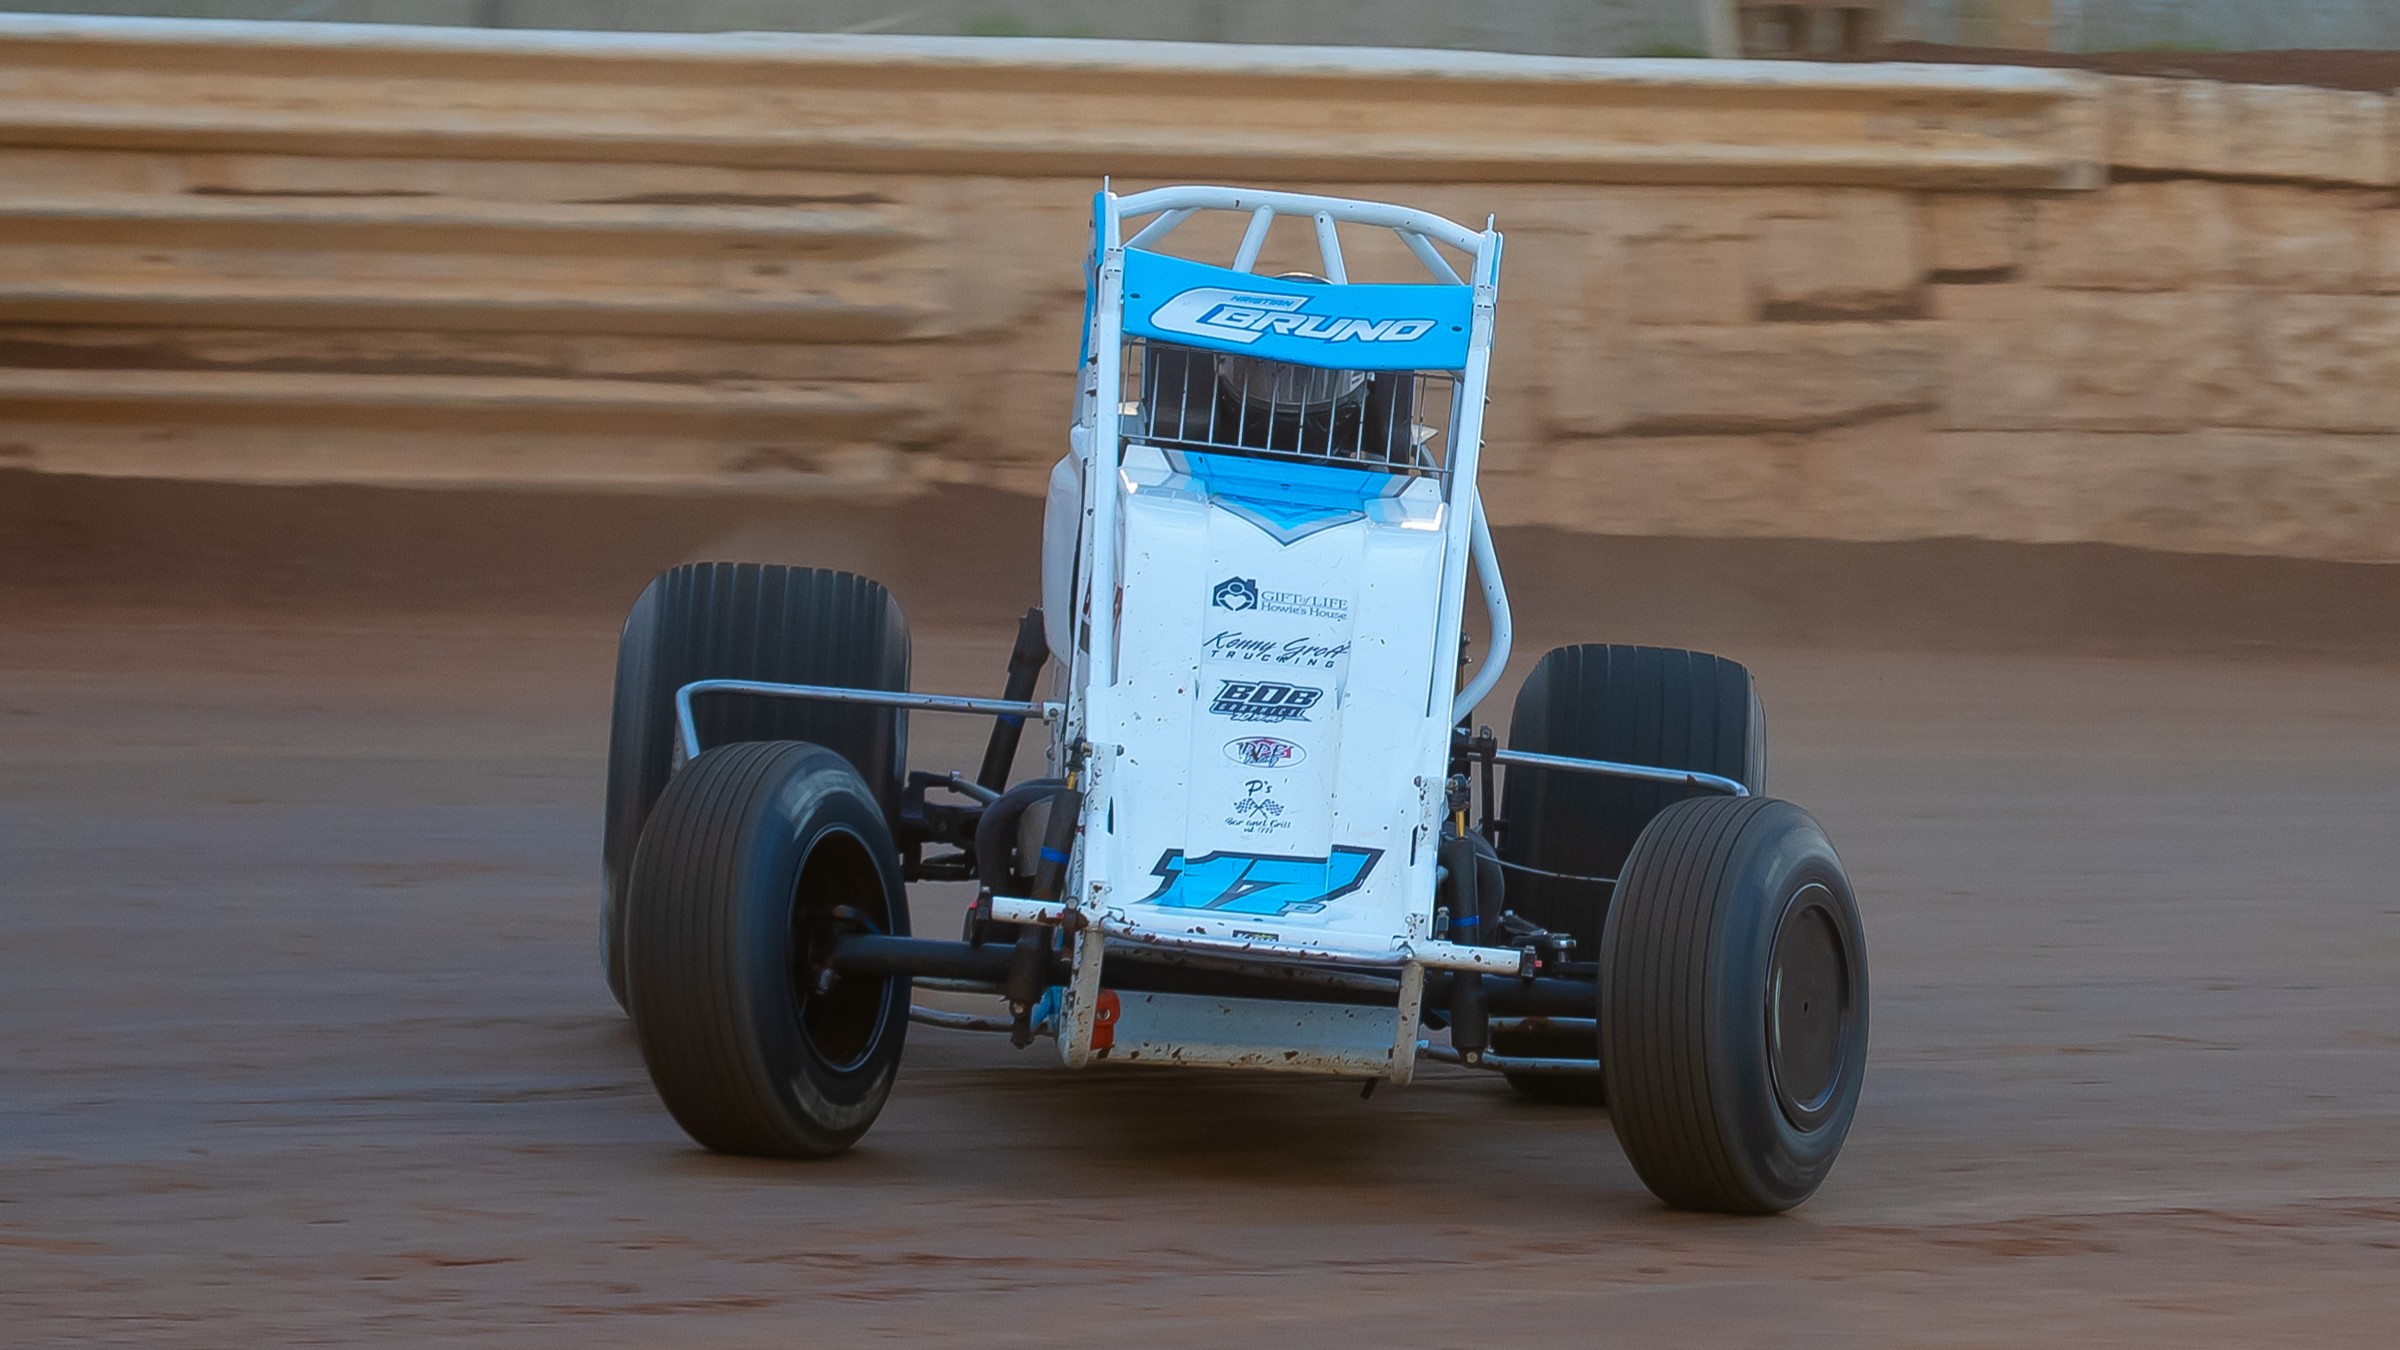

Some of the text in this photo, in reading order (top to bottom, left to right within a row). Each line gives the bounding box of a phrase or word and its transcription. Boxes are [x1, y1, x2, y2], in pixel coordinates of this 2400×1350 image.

[1261, 591, 1302, 604] GIFT
[1313, 596, 1348, 611] LIFE
[1261, 602, 1347, 620] Howie's House
[1203, 631, 1276, 657] Kenny
[1211, 650, 1335, 669] TRUCKING
[1245, 780, 1272, 797] P's
